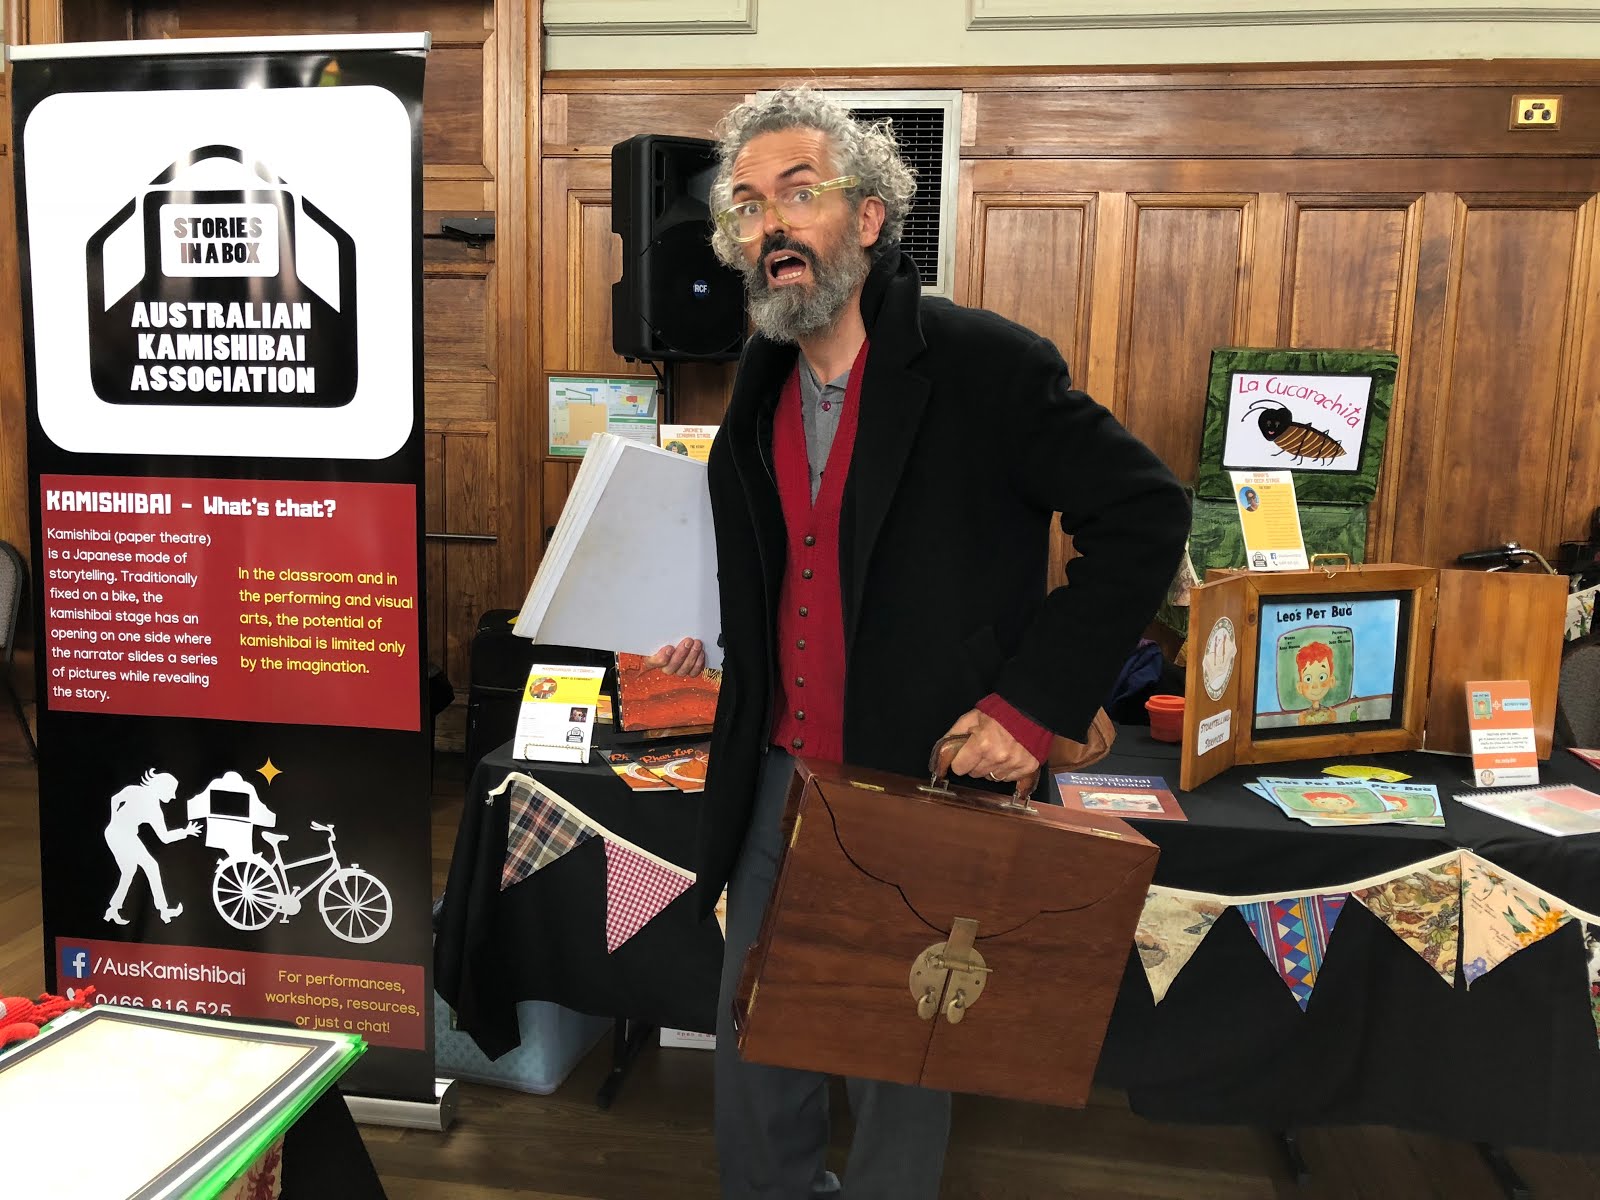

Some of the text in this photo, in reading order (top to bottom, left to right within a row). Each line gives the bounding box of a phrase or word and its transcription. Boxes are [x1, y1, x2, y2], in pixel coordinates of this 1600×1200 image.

[173, 217, 262, 238] STORIES
[180, 243, 261, 264] IN A BOX
[694, 284, 708, 293] RCF
[130, 302, 312, 329] AUSTRALIAN
[137, 333, 306, 362] KAMISHIBAI
[130, 365, 316, 394] ASSOCIATION
[1238, 376, 1362, 428] La Cucarachita
[46, 489, 172, 515] KAMISHIBAI
[203, 495, 270, 517] What's
[274, 497, 337, 519] that?
[47, 527, 212, 547] Kamishibai (paper theatre)
[47, 547, 188, 564] is a Japanese mode of
[49, 567, 198, 588] storytelling. Traditionally
[238, 567, 398, 585] In the classroom and in
[49, 586, 164, 605] fixed on a bike, the
[239, 588, 413, 609] the performing and visual
[49, 606, 199, 626] kamishibai stage has an
[239, 612, 383, 630] arts, the potential of
[1277, 608, 1302, 623] Leo's
[50, 627, 212, 645] opening on one side where
[239, 634, 406, 657] kamishibai is limited only
[51, 646, 219, 666] the narrator slides a series
[240, 655, 369, 675] by the imagination.
[51, 665, 210, 688] of pictures while revealing
[52, 685, 110, 703] the story.
[608, 753, 630, 762] Ph
[1070, 775, 1151, 784] Kamishibai
[93, 957, 246, 986] /AusKamishibai
[278, 970, 406, 995] For performances,
[265, 992, 420, 1017] workshops, resources,
[295, 1014, 391, 1033] or just a chat!
